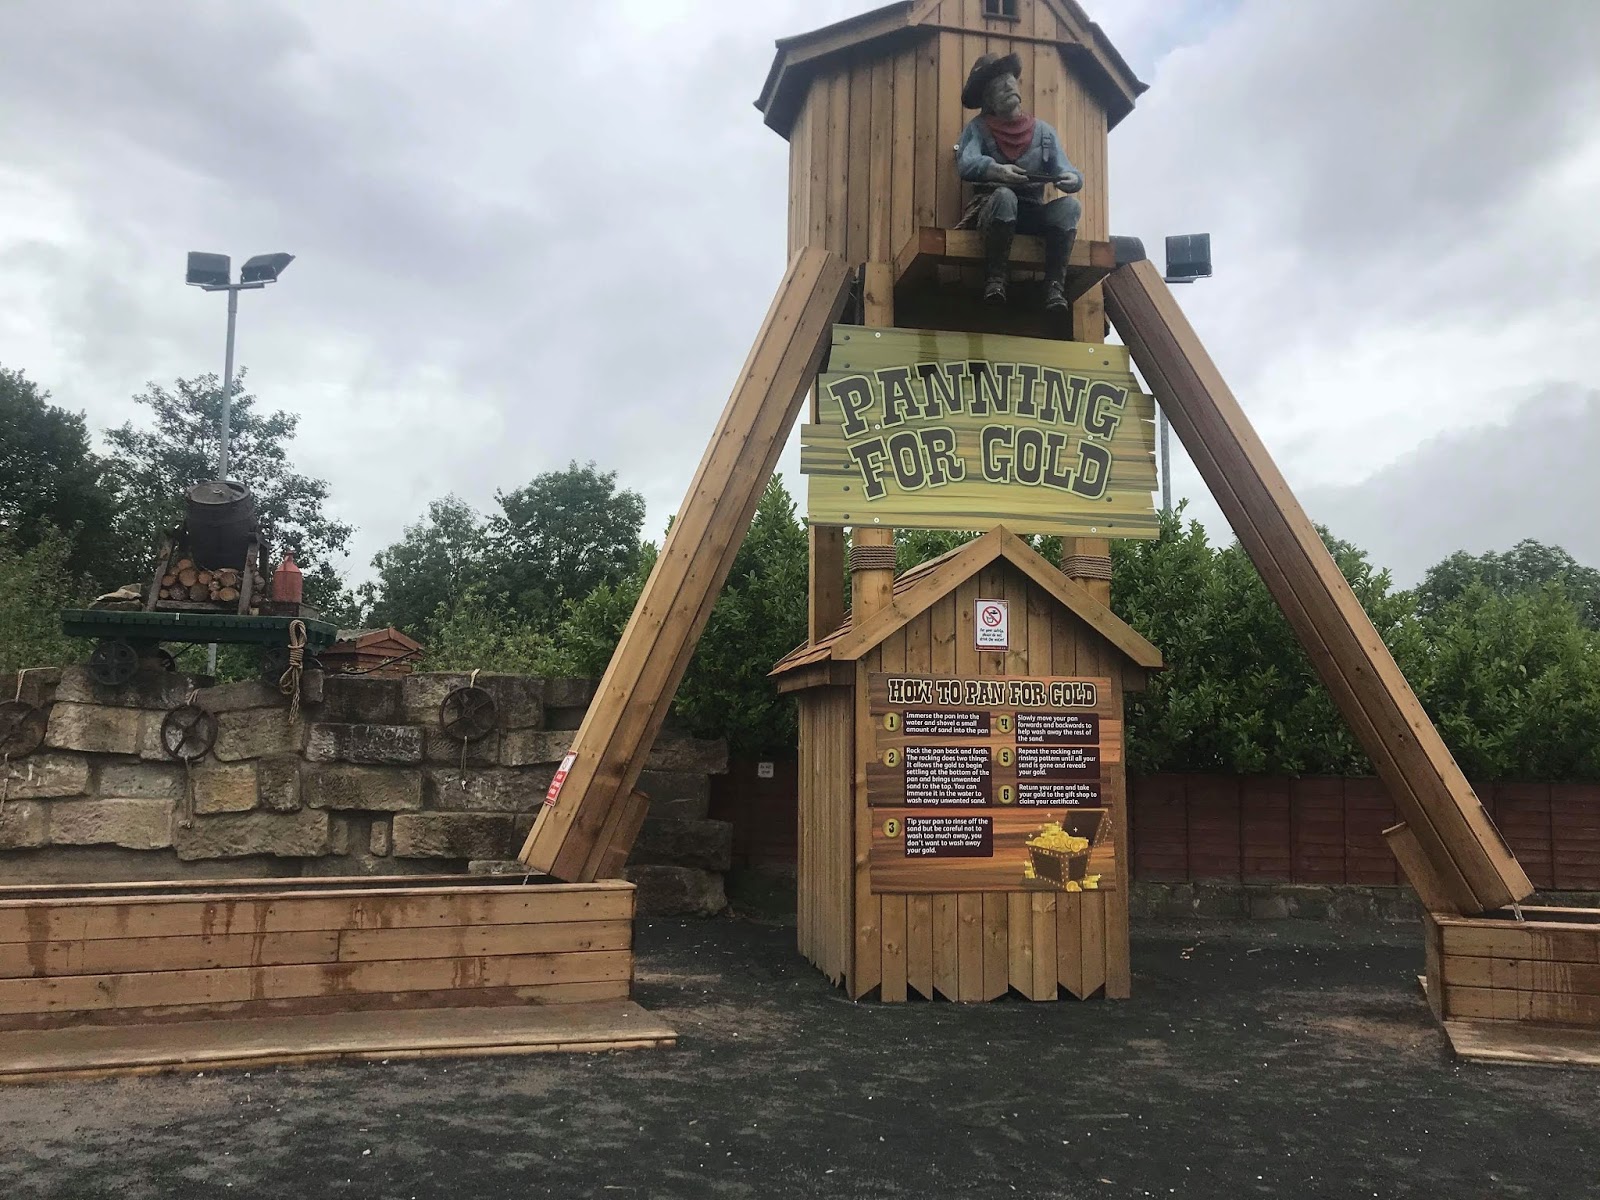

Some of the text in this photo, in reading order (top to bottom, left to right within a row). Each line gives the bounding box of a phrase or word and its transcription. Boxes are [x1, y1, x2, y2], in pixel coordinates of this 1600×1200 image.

[827, 359, 1129, 441] PANNING
[847, 424, 1113, 502] FOR GOLD
[888, 678, 1097, 708] HOW TO PAN FOR GOLD
[890, 716, 894, 728] 1
[1001, 719, 1007, 729] 4
[888, 752, 894, 763] 2
[1003, 752, 1008, 762] 5
[1003, 788, 1009, 800] 6
[888, 822, 895, 833] 3
